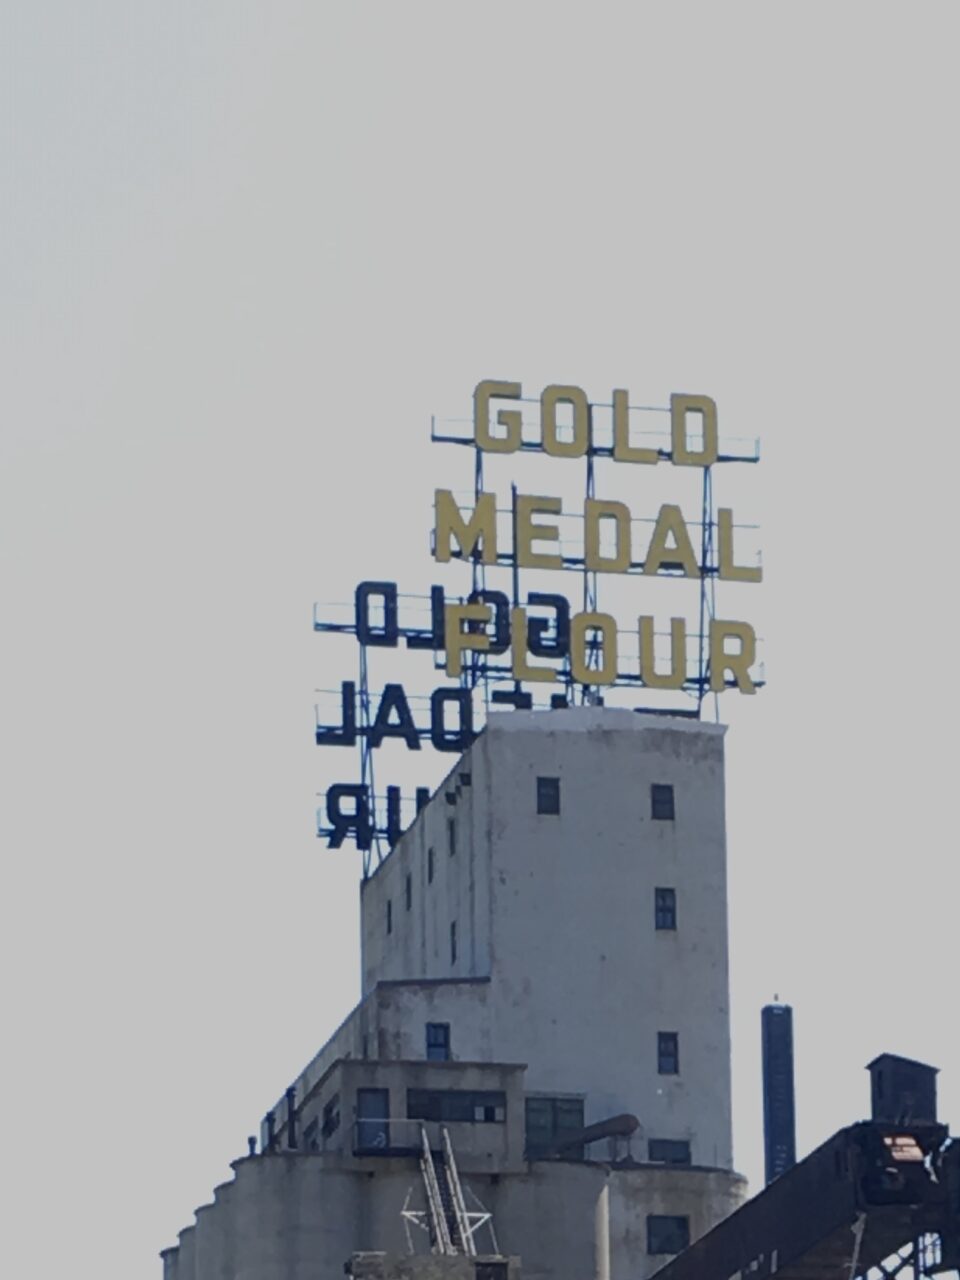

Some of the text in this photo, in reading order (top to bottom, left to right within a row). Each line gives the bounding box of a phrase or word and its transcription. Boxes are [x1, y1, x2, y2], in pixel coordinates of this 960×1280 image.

[473, 380, 719, 467] GOLD
[434, 489, 763, 583] MEDAL
[443, 601, 757, 695] FLOUR
